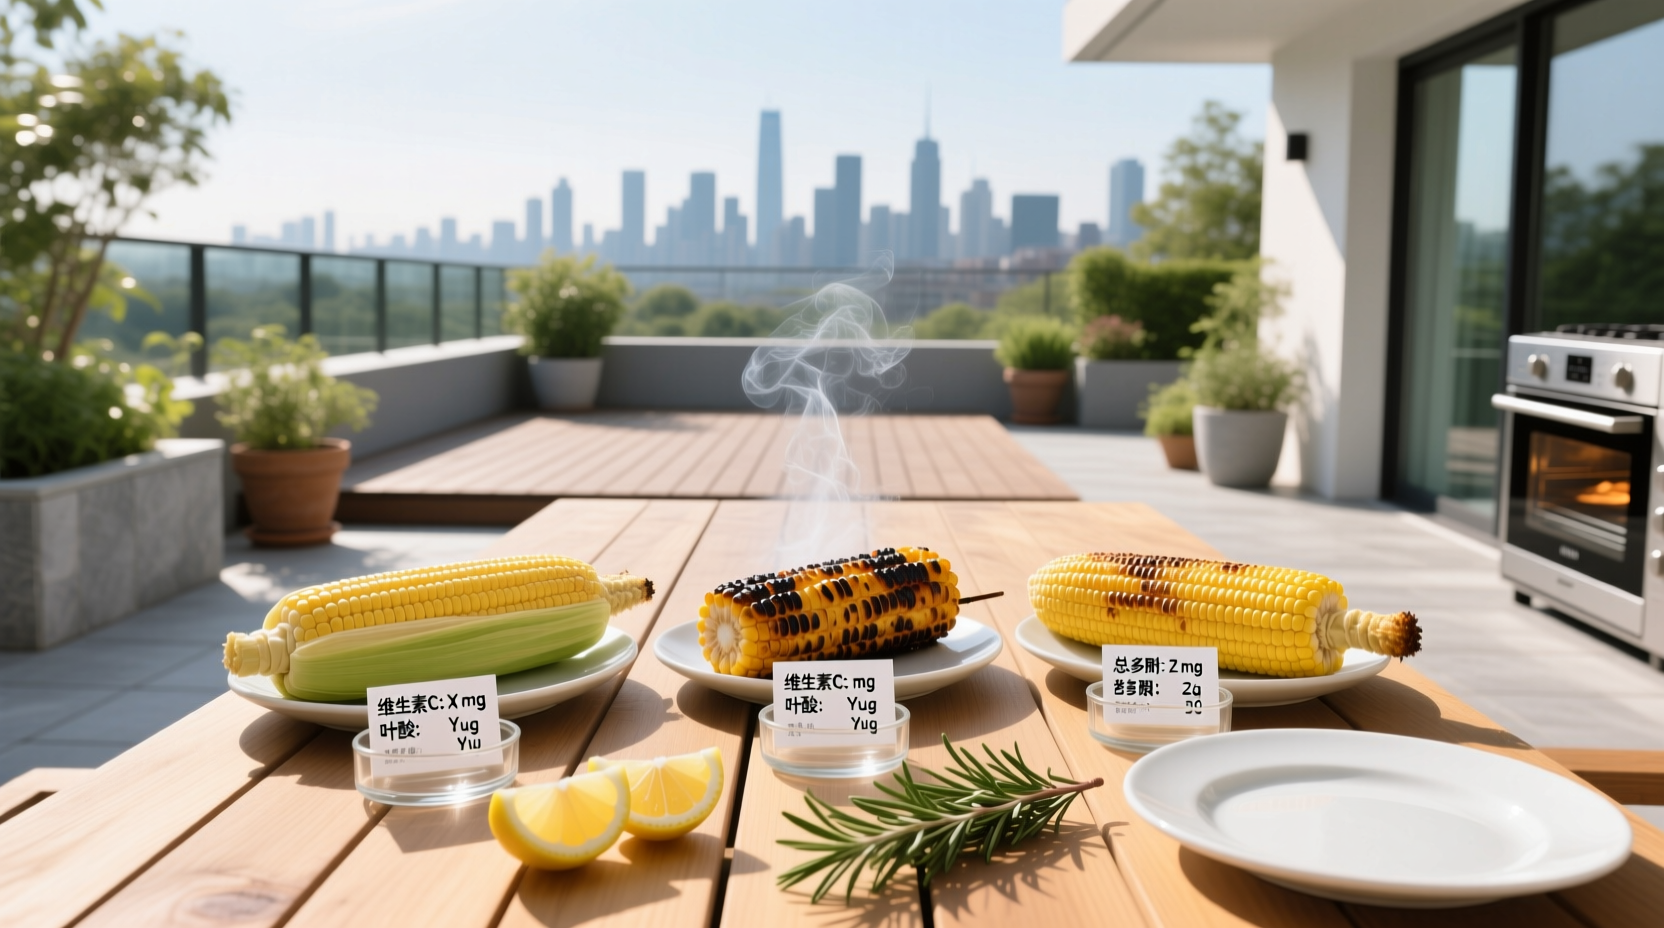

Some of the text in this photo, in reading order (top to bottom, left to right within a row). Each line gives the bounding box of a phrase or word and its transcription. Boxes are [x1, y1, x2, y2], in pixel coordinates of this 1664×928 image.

[784, 672, 875, 692] 维生素C: mg
[785, 695, 877, 715] 叶酸: Yug
[380, 716, 479, 741] 叶酸: Yug
[851, 716, 878, 735] Yug
